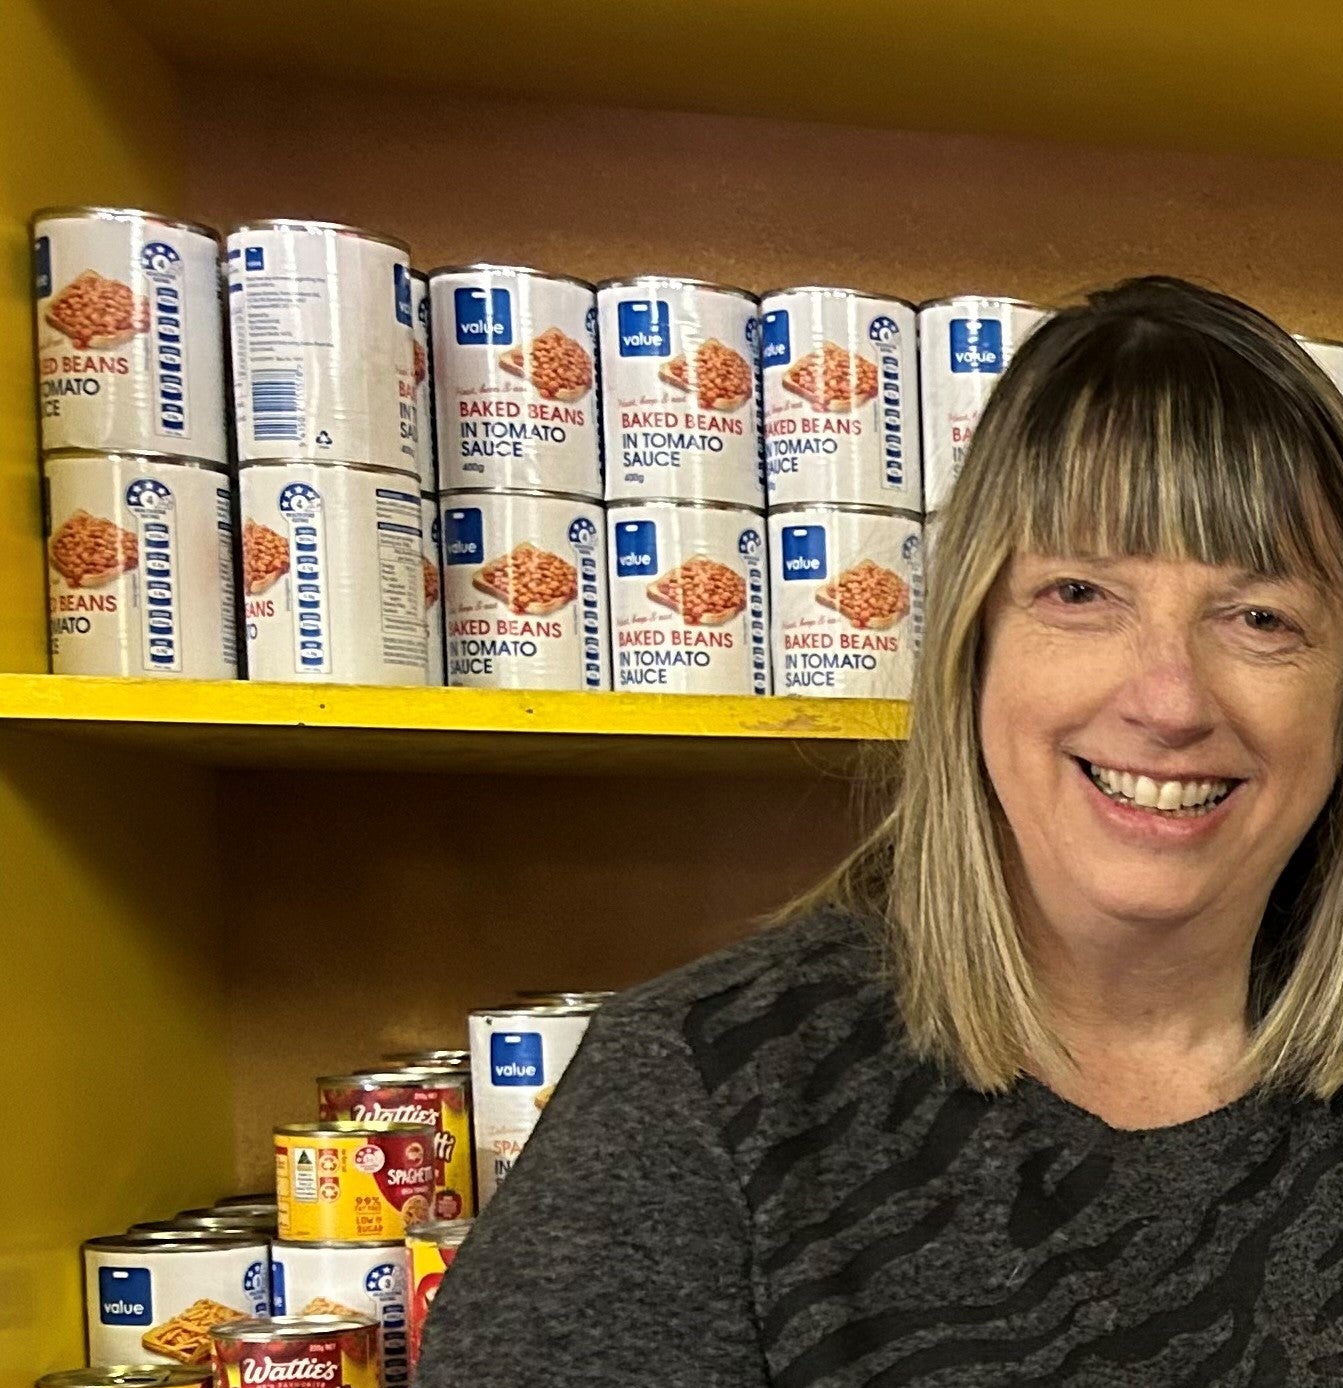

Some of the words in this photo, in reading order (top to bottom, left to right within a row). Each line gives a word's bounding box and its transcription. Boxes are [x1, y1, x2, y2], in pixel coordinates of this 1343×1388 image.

[461, 319, 504, 336] value
[623, 334, 662, 348] value
[62, 356, 129, 375] BEANS
[955, 351, 997, 364] value
[460, 401, 520, 419] BAKED
[528, 404, 585, 426] BEANS
[621, 412, 678, 429] BAKED
[685, 414, 743, 436] BEANS
[802, 419, 862, 436] BEANS
[460, 422, 478, 439] IN
[482, 422, 566, 444] TOMATO
[461, 441, 523, 458] SAUCE
[622, 433, 638, 449] IN
[644, 433, 723, 452] TOMATO
[774, 438, 838, 456] TOMATO
[623, 451, 680, 468] SAUCE
[619, 552, 651, 567] value
[785, 557, 820, 572] value
[59, 594, 118, 614] BEANS
[496, 620, 562, 639] BEANS
[619, 629, 665, 648] BAKED
[672, 630, 734, 649] BEANS
[784, 633, 834, 650] BAKED
[839, 633, 899, 651] BEANS
[462, 641, 538, 658] TOMATO
[619, 651, 631, 667] IN
[635, 650, 710, 668] TOMATO
[785, 653, 798, 669] IN
[800, 652, 877, 671] TOMATO
[620, 669, 668, 686] SAUCE
[785, 671, 835, 688] SAUCE
[494, 1062, 537, 1077] value
[103, 1300, 145, 1316] value
[242, 1356, 339, 1385] Wattie's
